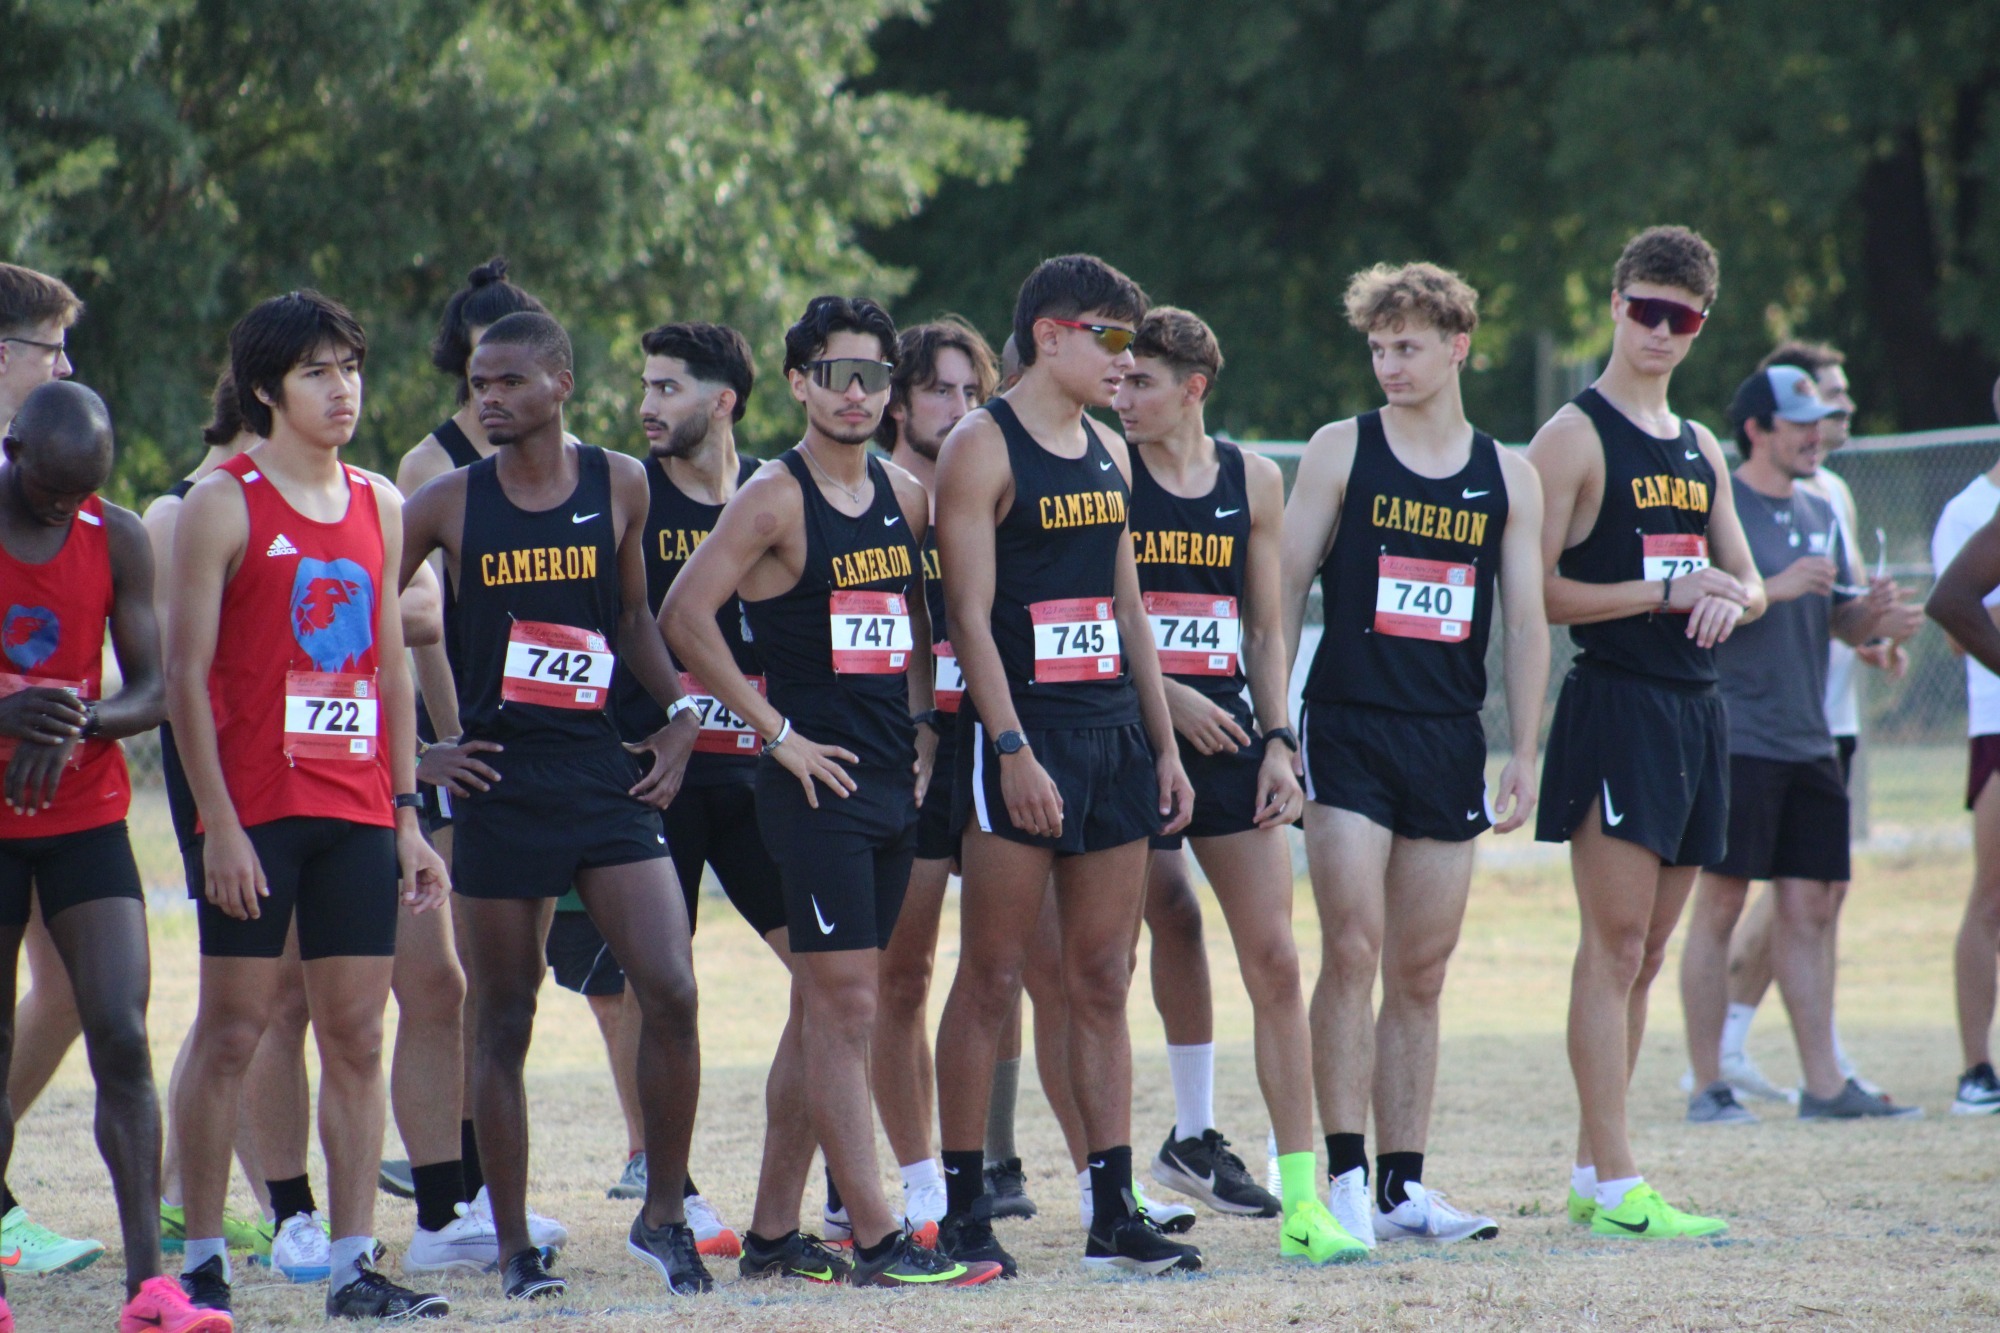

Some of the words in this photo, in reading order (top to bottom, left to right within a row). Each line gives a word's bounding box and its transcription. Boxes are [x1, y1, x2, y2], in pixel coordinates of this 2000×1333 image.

[1039, 490, 1125, 529] CAMERON
[1372, 493, 1489, 546] CAMERON
[266, 547, 298, 557] adidas
[1129, 530, 1234, 567] CAMERON
[481, 546, 597, 587] CAMERON
[831, 544, 912, 588] CAMERON
[1395, 583, 1452, 615] 740
[845, 617, 895, 647] 747
[1052, 624, 1105, 655] 745
[1160, 619, 1220, 649] 744
[528, 648, 593, 683] 742
[305, 699, 360, 732] 722
